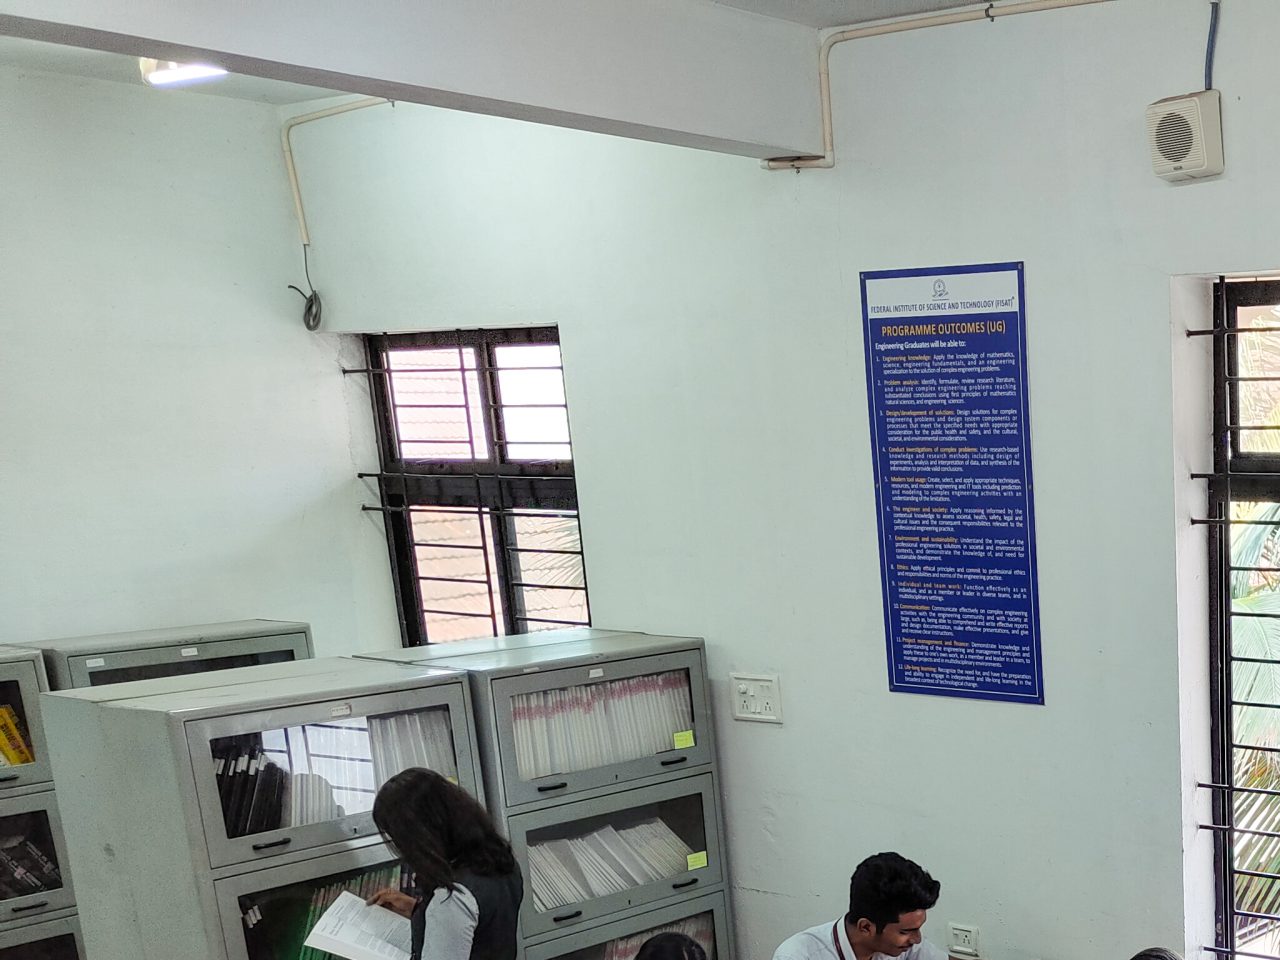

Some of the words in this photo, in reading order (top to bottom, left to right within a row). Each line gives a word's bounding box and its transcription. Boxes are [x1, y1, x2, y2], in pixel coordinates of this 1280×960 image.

[870, 305, 892, 314] FEDERAL
[893, 304, 918, 313] INSTITUTE
[918, 303, 926, 311] OF
[926, 302, 947, 311] SCIENCE
[948, 302, 959, 310] AND
[960, 300, 994, 309] TECHNOLOGY
[881, 324, 936, 337] PROGRAMME
[938, 322, 985, 335] OUTCOMES
[986, 320, 1006, 335] (UG)
[875, 342, 904, 351] Engineering
[904, 341, 930, 349] Graduates
[939, 340, 946, 348] be
[947, 340, 958, 348] able
